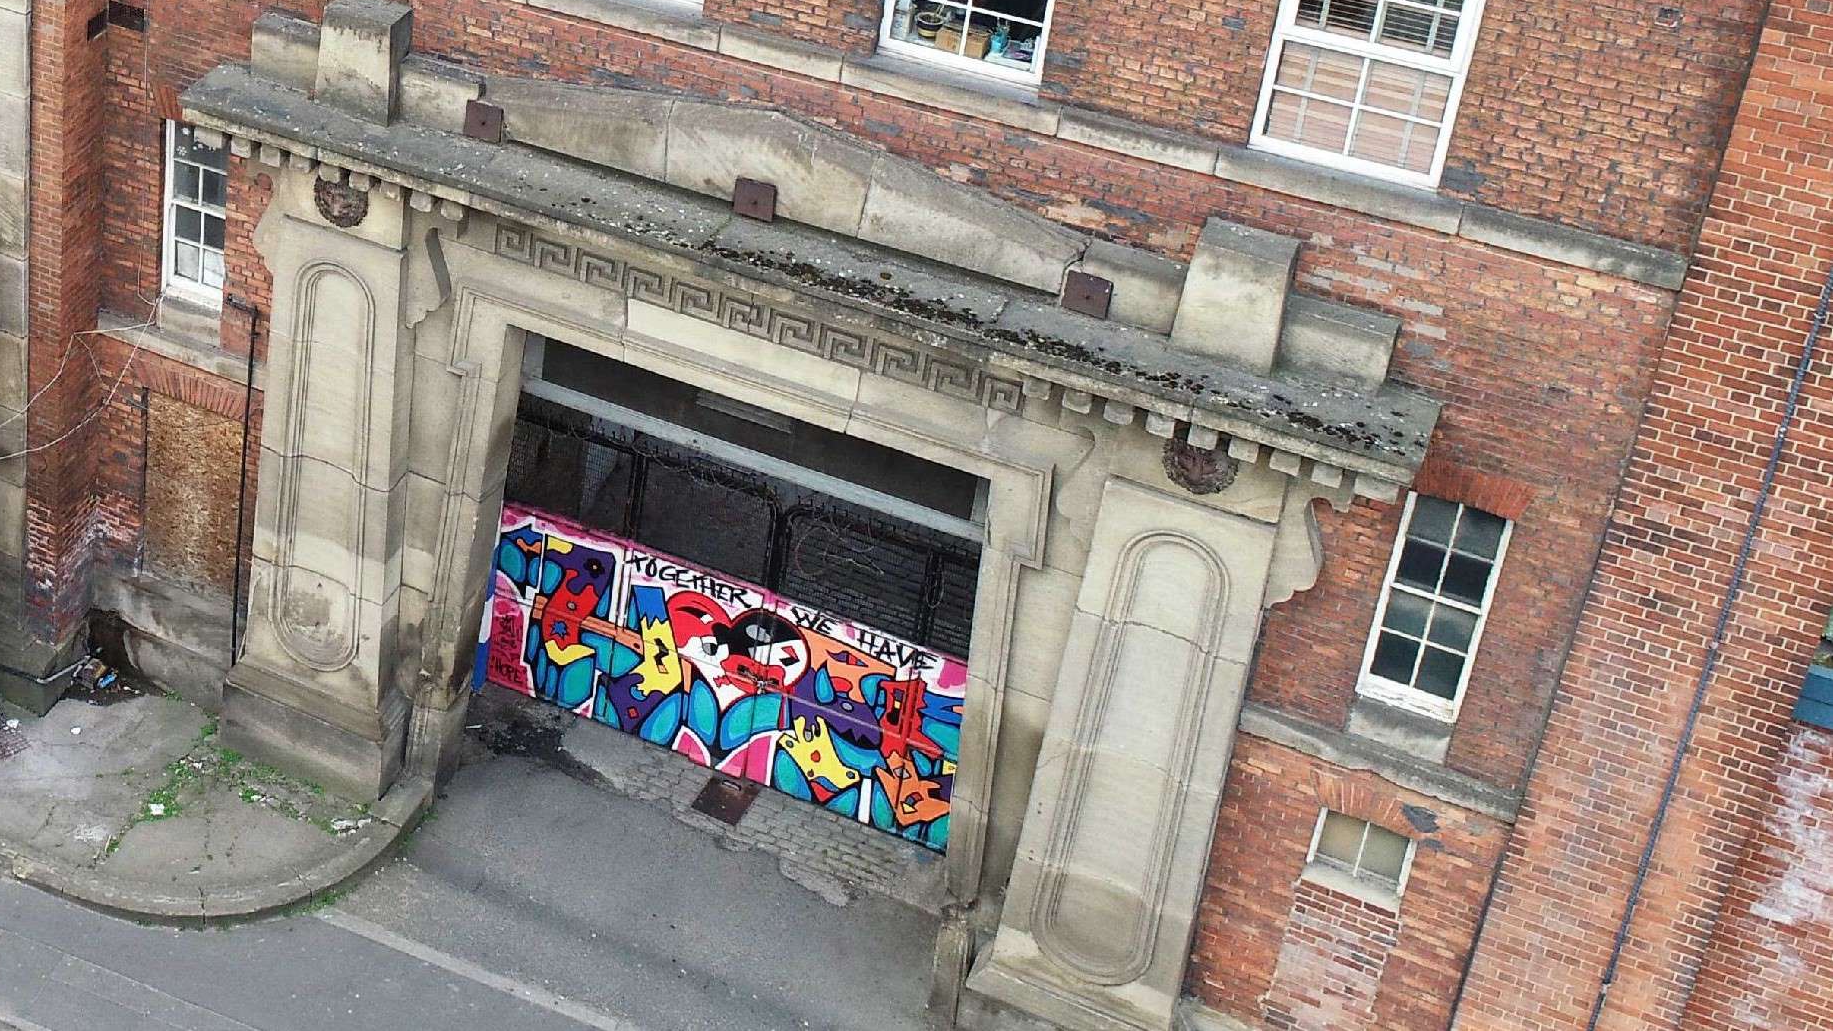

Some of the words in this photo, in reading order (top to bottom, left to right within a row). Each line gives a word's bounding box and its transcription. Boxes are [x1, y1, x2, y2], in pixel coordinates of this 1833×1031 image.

[627, 554, 752, 608] TOGETHER
[792, 607, 833, 636] WE
[857, 630, 940, 670] HAVE
